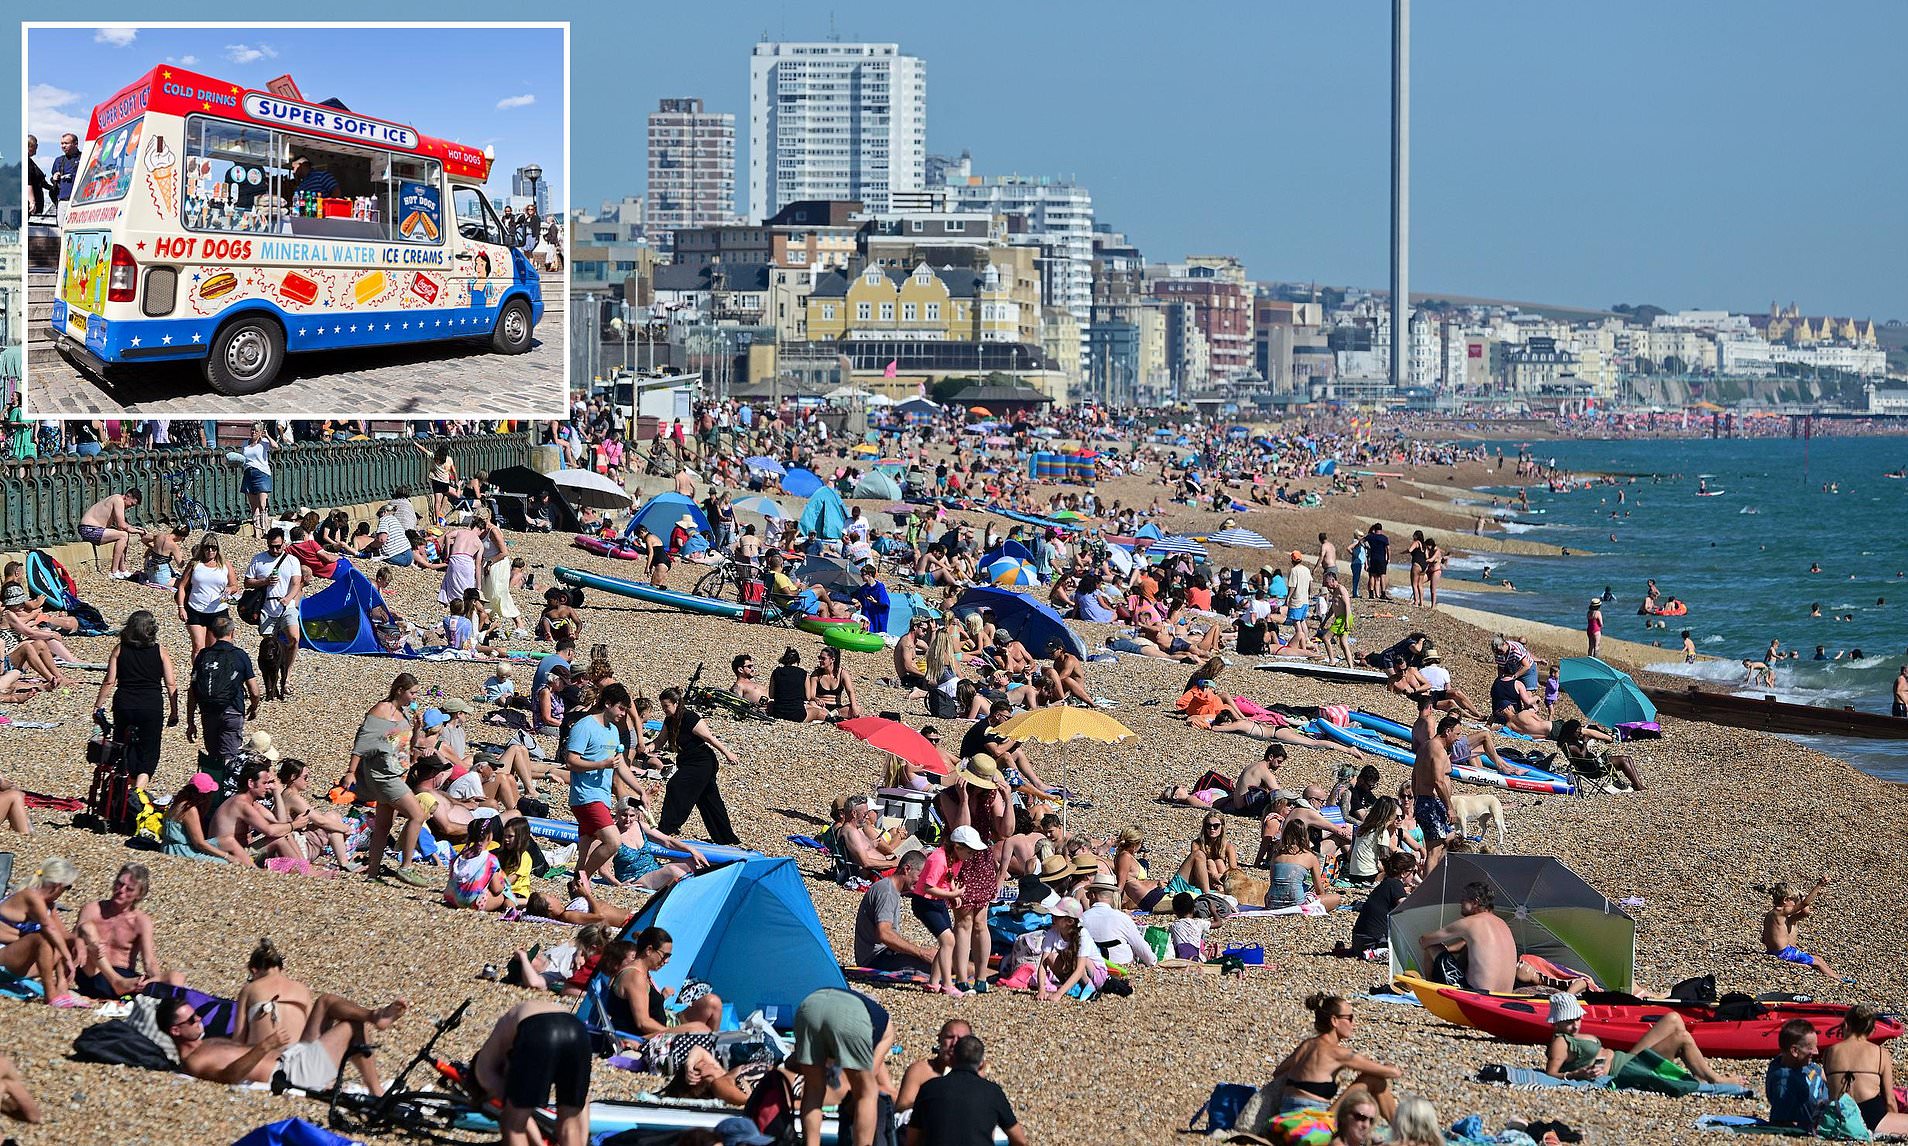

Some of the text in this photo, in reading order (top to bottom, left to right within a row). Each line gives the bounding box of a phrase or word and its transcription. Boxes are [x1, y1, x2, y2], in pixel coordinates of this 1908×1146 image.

[163, 82, 237, 107] COLD DRINKS
[97, 106, 118, 130] SUPER
[119, 94, 137, 119] SOFT
[259, 100, 407, 144] SUPER SOFT ICE
[447, 149, 481, 165] HOT DOGS
[403, 196, 418, 206] HOT
[419, 197, 436, 211] DOGS
[154, 236, 443, 265] HOT DOGS MINERAL WATER ICE CREAMS
[1351, 741, 1389, 757] ALLROUND
[1468, 775, 1500, 786] mistral
[541, 827, 556, 837] FEET
